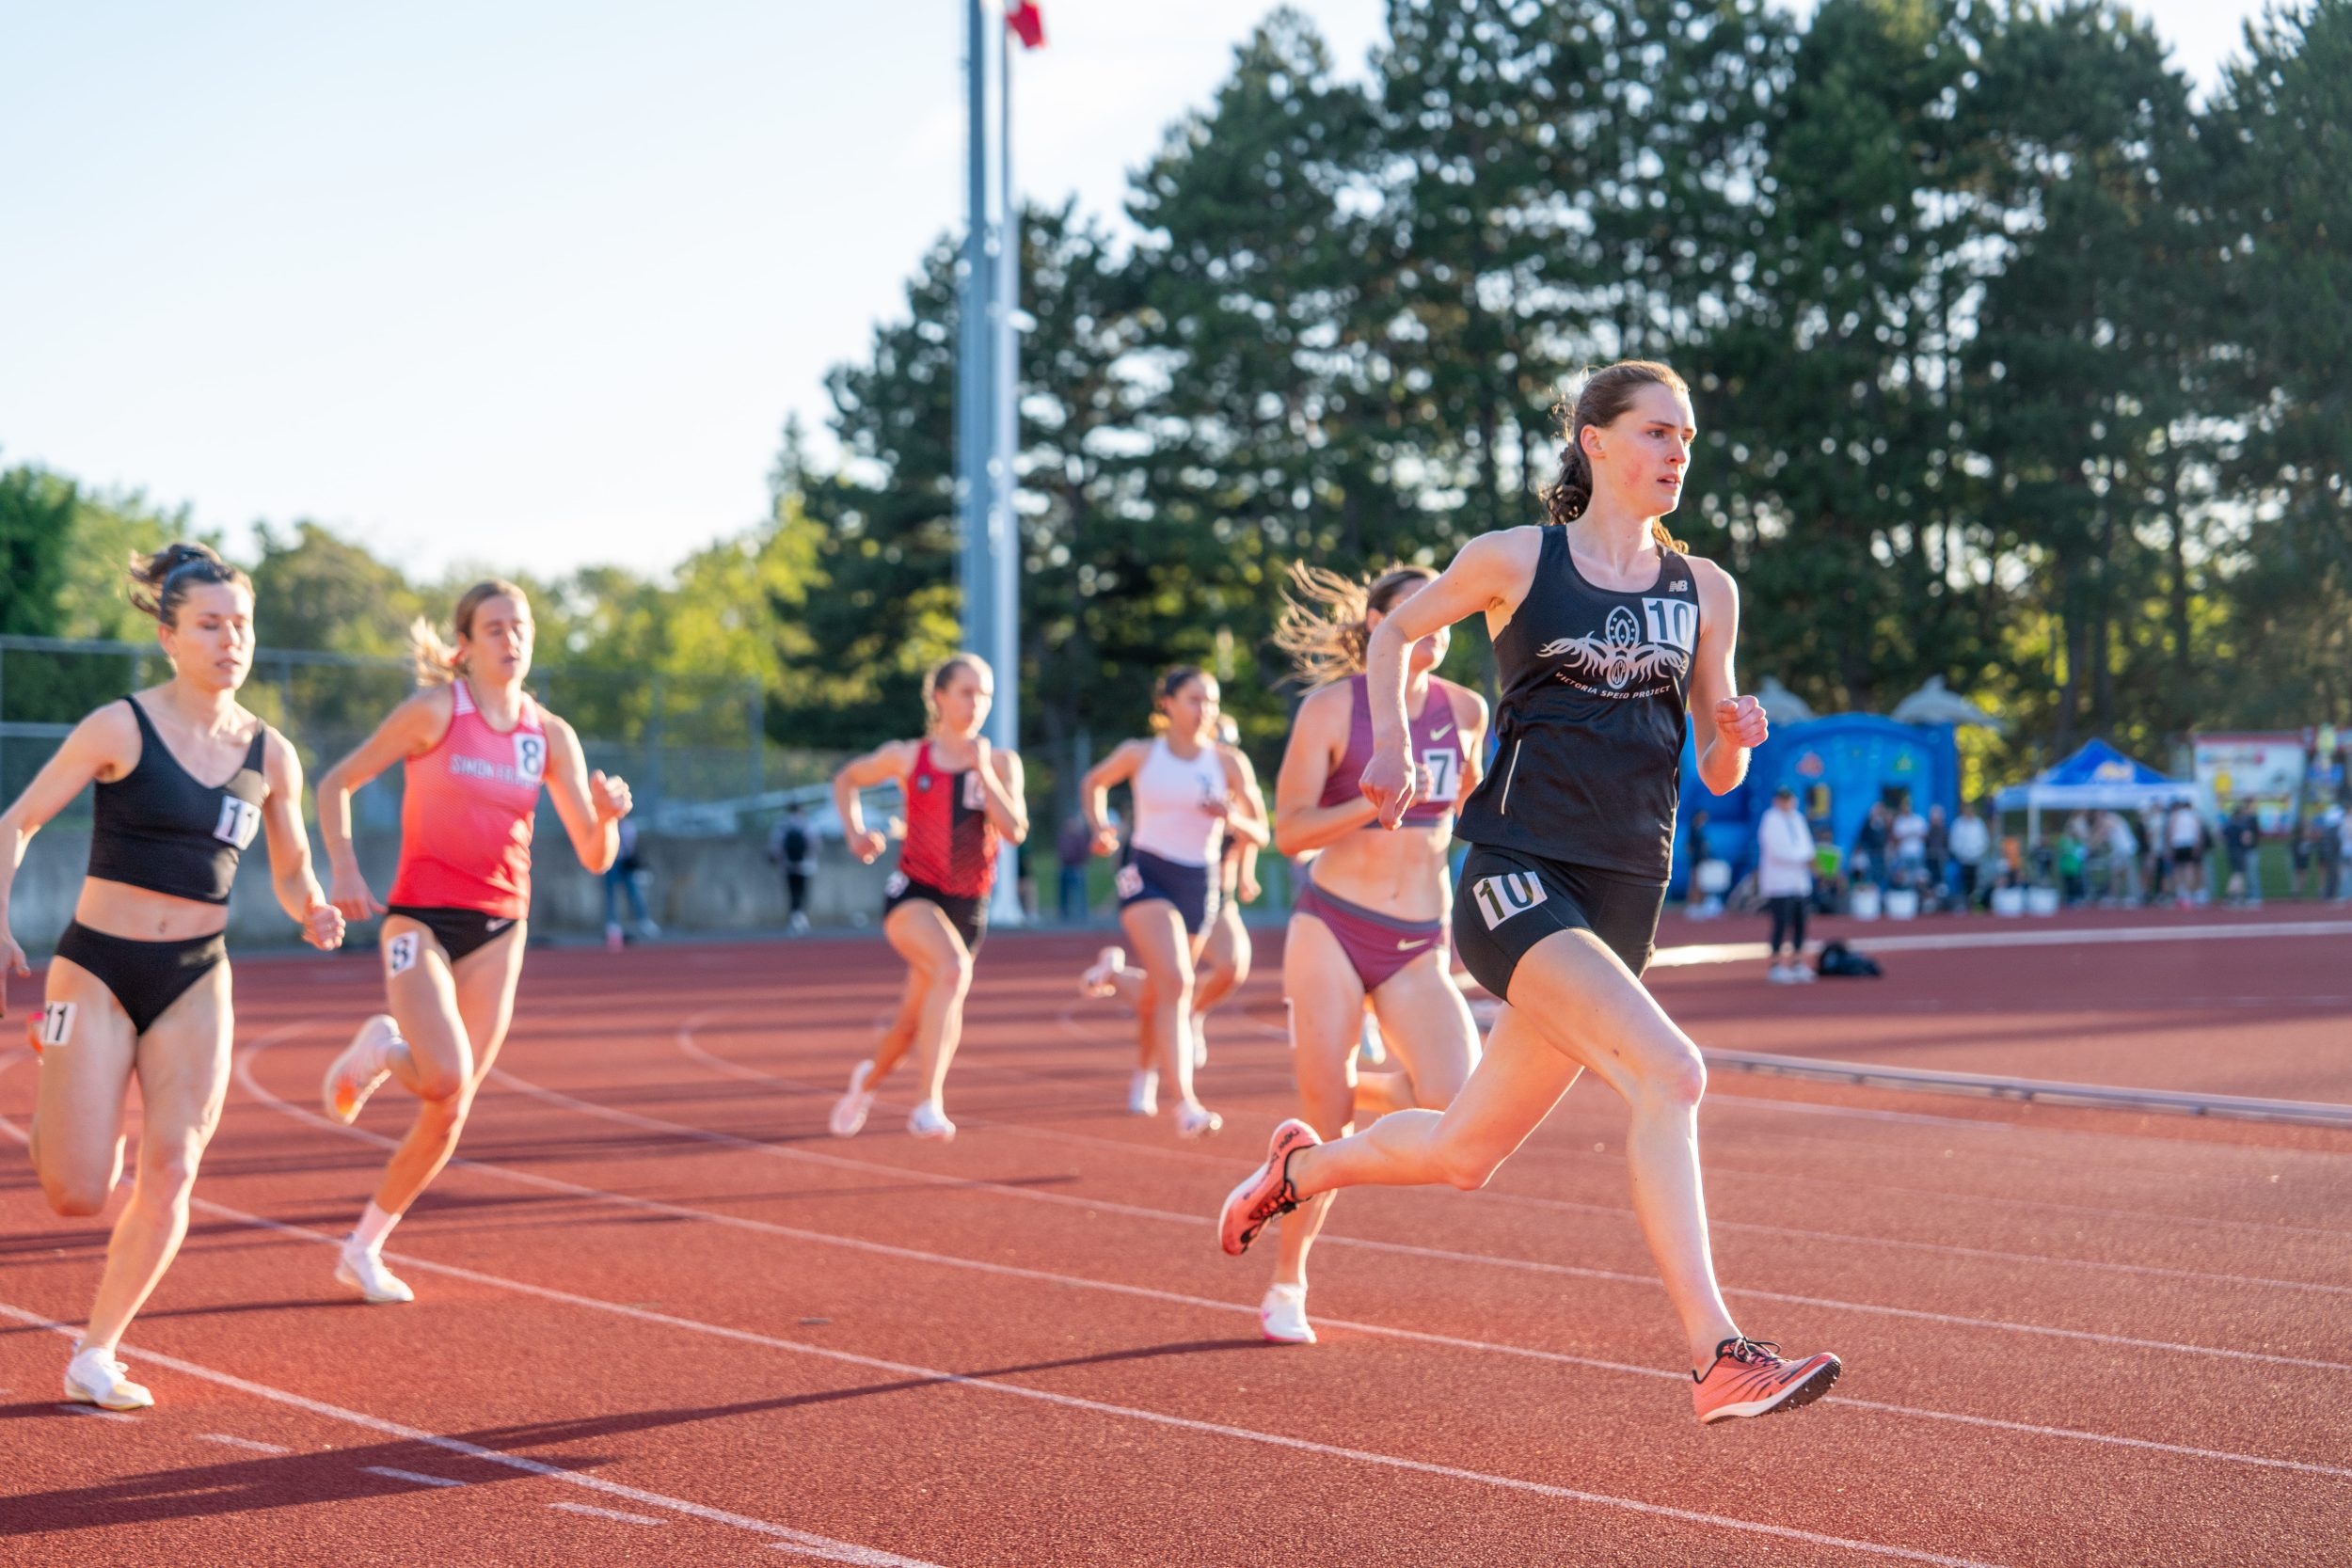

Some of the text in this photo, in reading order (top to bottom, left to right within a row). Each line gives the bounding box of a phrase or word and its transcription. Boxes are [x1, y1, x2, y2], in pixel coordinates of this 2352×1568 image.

[1648, 600, 1691, 647] 10
[1555, 672, 1671, 699] VICTORIA SPEED PROJECT
[521, 739, 539, 776] 8
[1429, 754, 1450, 796] 7
[1479, 873, 1534, 921] 10
